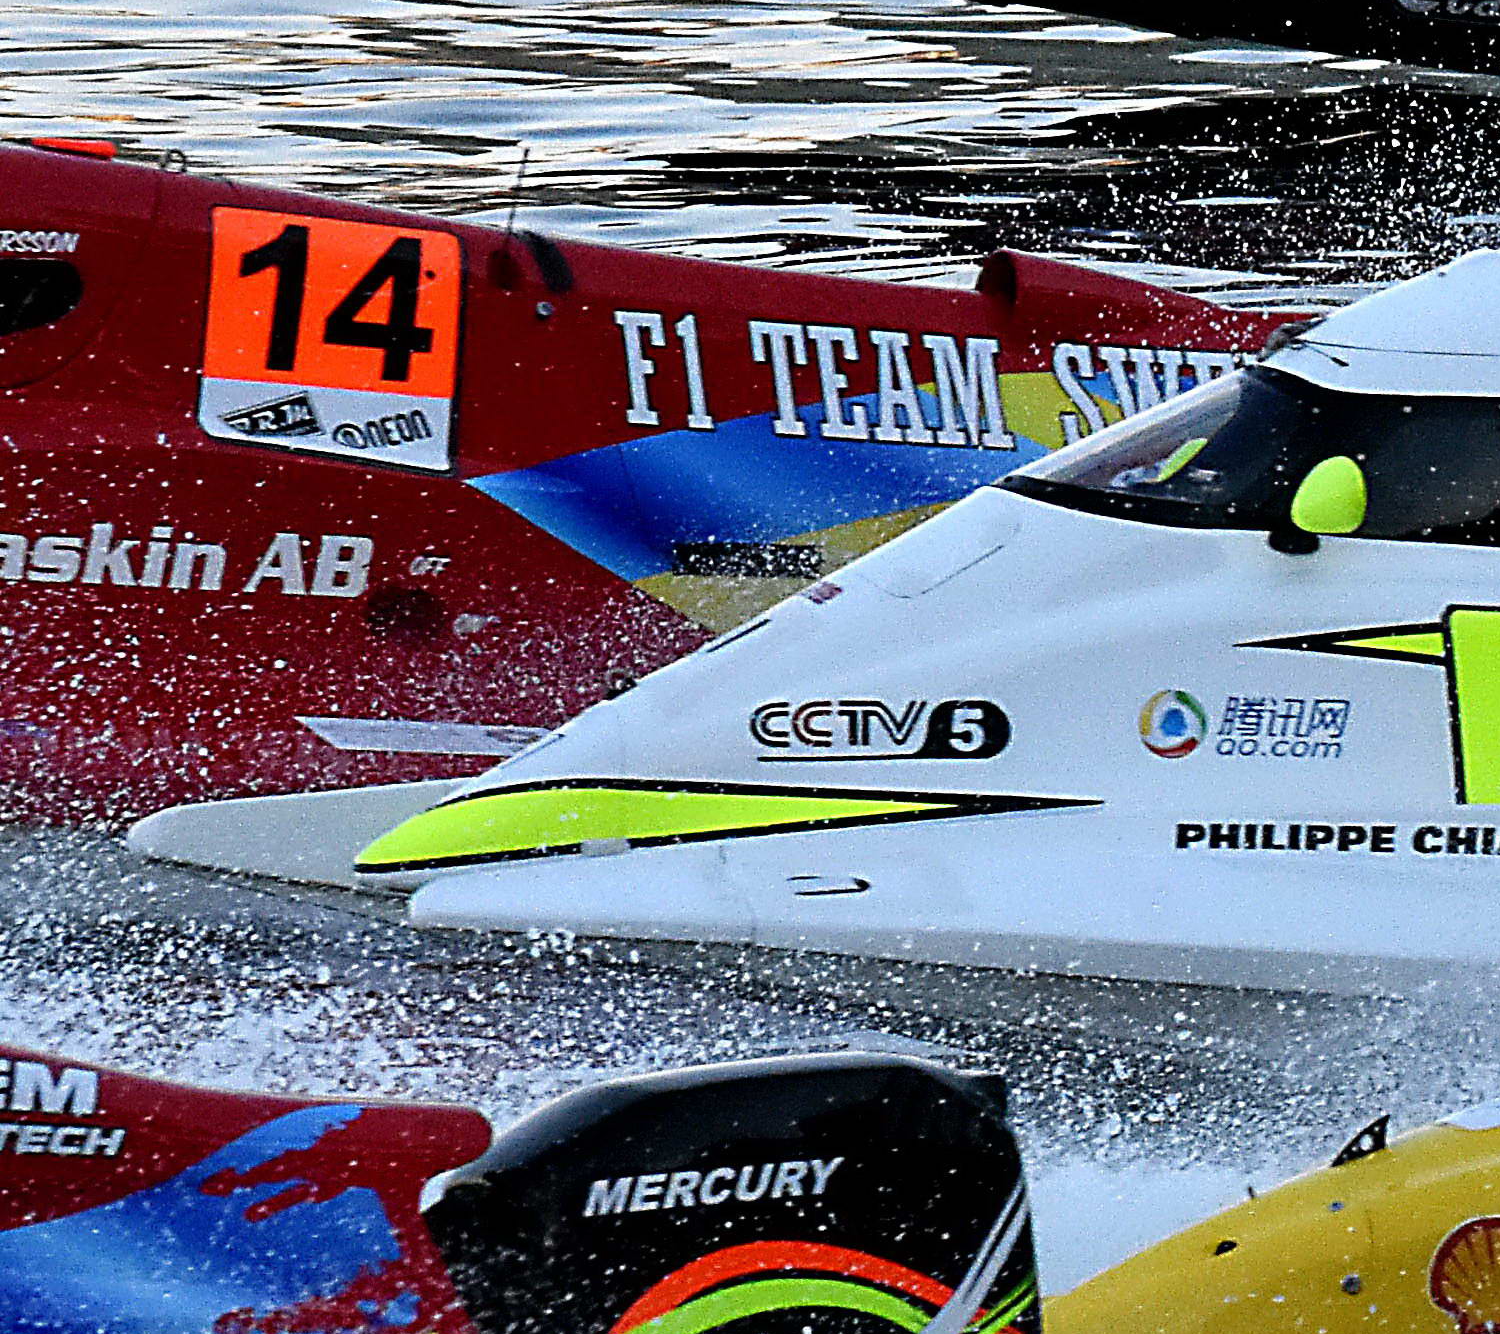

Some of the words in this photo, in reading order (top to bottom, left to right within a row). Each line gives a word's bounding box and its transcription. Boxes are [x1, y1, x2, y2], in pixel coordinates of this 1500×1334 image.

[238, 224, 436, 383] 14
[613, 310, 715, 431] F1
[749, 319, 1017, 450] TEAM
[242, 532, 375, 599] AB
[1215, 695, 1351, 740] 腾讯网
[1176, 822, 1397, 855] PHILIPPE
[0, 1059, 98, 1117] M
[583, 1156, 843, 1217] MERCURY
